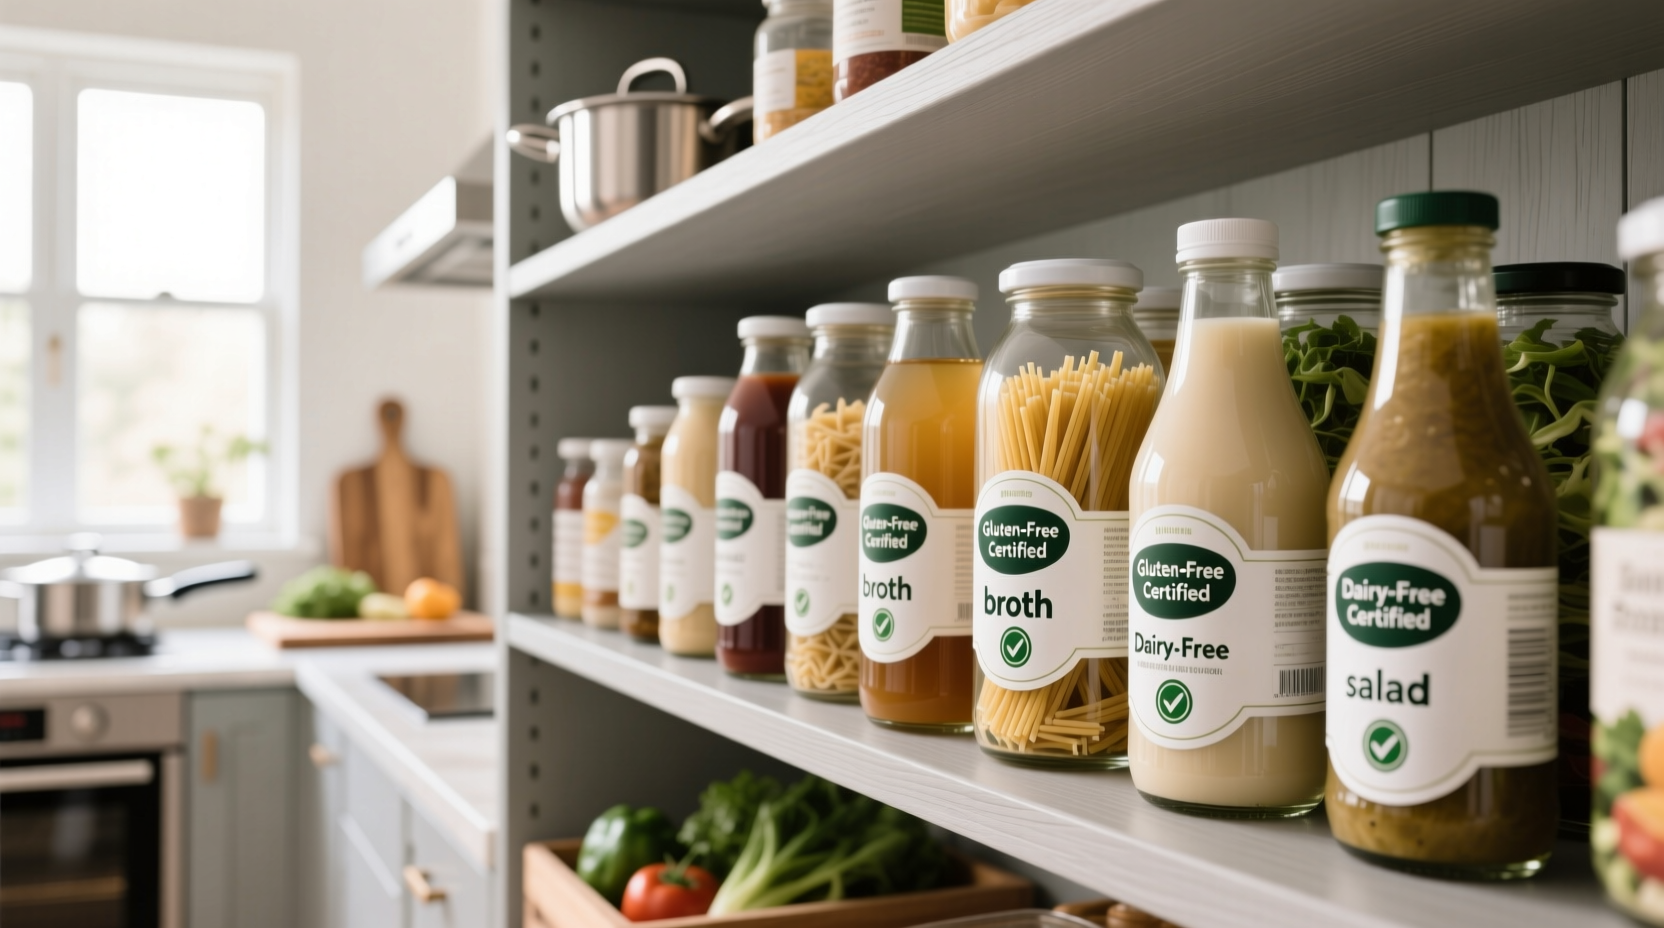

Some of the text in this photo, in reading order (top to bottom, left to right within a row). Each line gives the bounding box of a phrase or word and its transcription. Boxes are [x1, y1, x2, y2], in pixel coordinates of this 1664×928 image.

[982, 520, 1059, 539] Gluten-Free
[988, 541, 1047, 559] Certified
[1137, 558, 1224, 580] Gluten-Free
[863, 574, 911, 601] broth
[1143, 581, 1211, 602] Certified
[1342, 578, 1446, 607] Dairy-Free
[984, 586, 1053, 618] broth
[1346, 605, 1430, 630] Certified
[1134, 632, 1229, 660] Dairy-Free
[1346, 670, 1430, 706] salad
